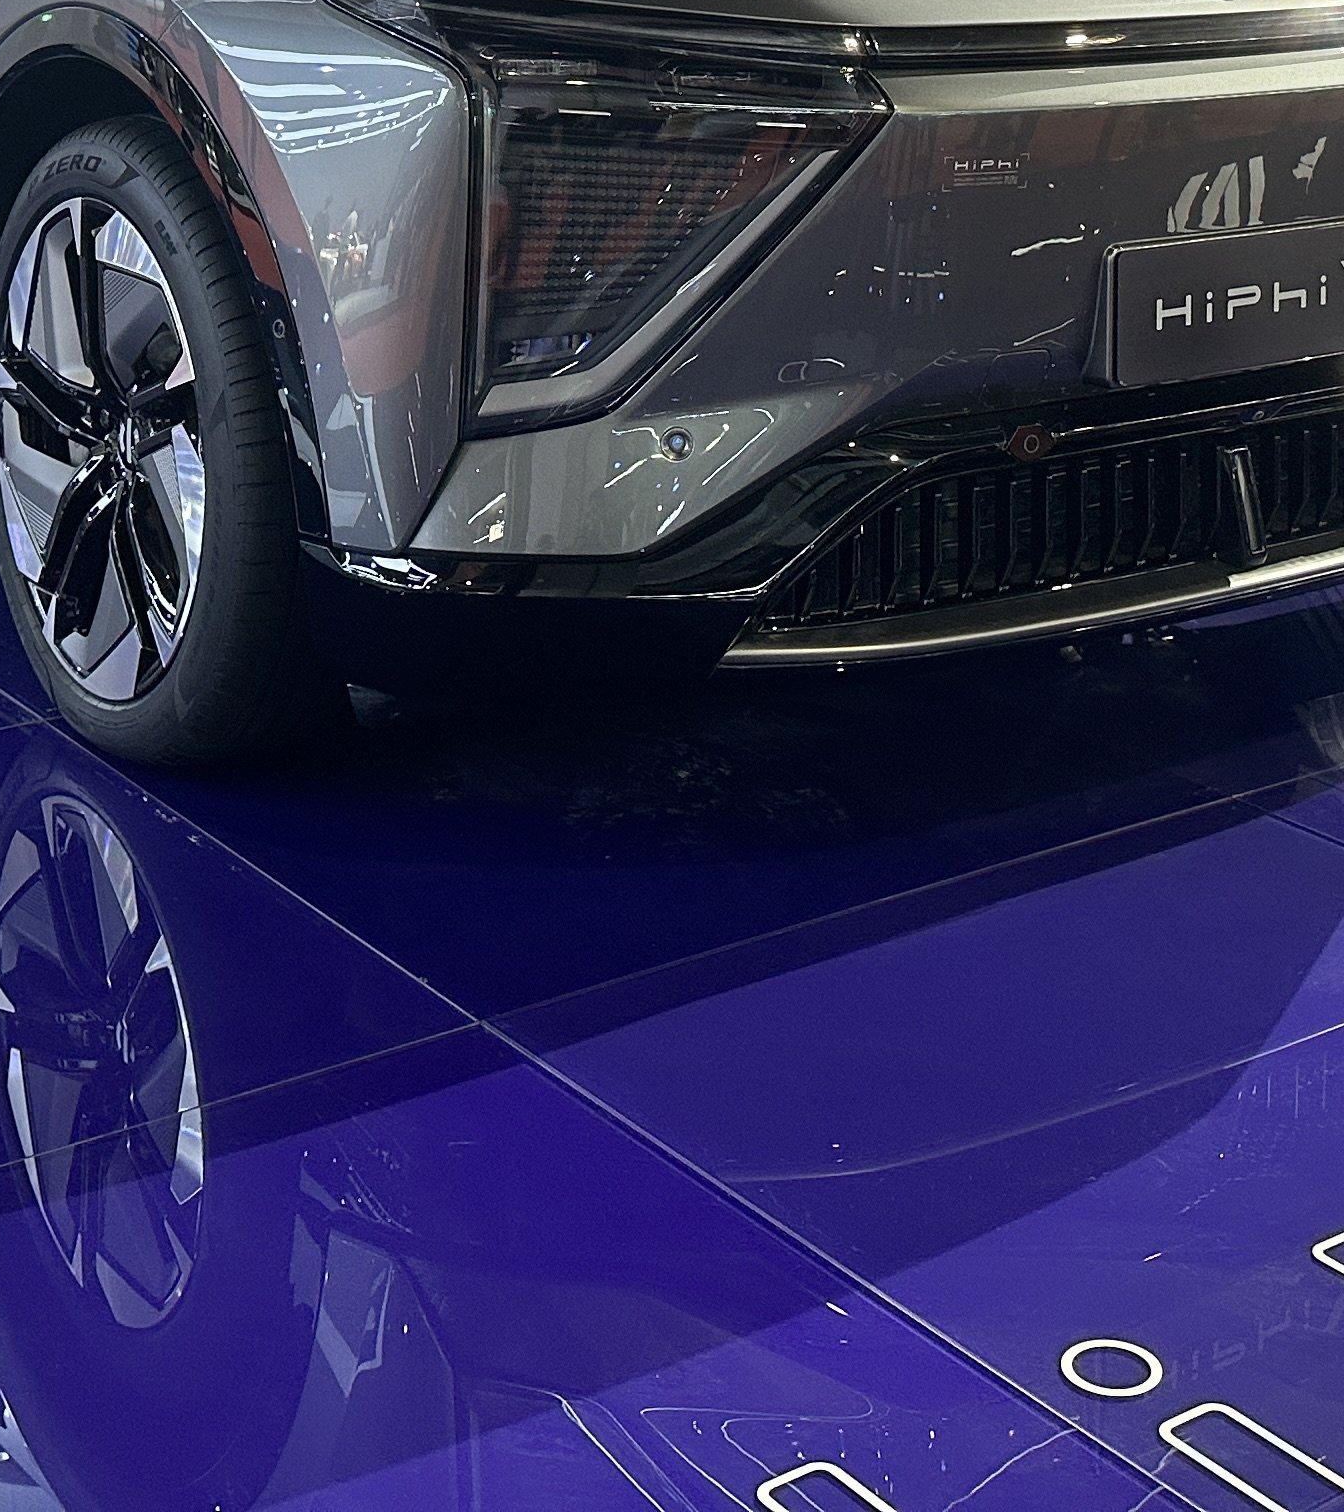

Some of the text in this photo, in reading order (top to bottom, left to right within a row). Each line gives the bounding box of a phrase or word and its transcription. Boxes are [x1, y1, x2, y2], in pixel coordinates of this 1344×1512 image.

[43, 154, 102, 182] ZERO
[954, 159, 1019, 170] HiPhi
[1156, 275, 1327, 331] HiPhi
